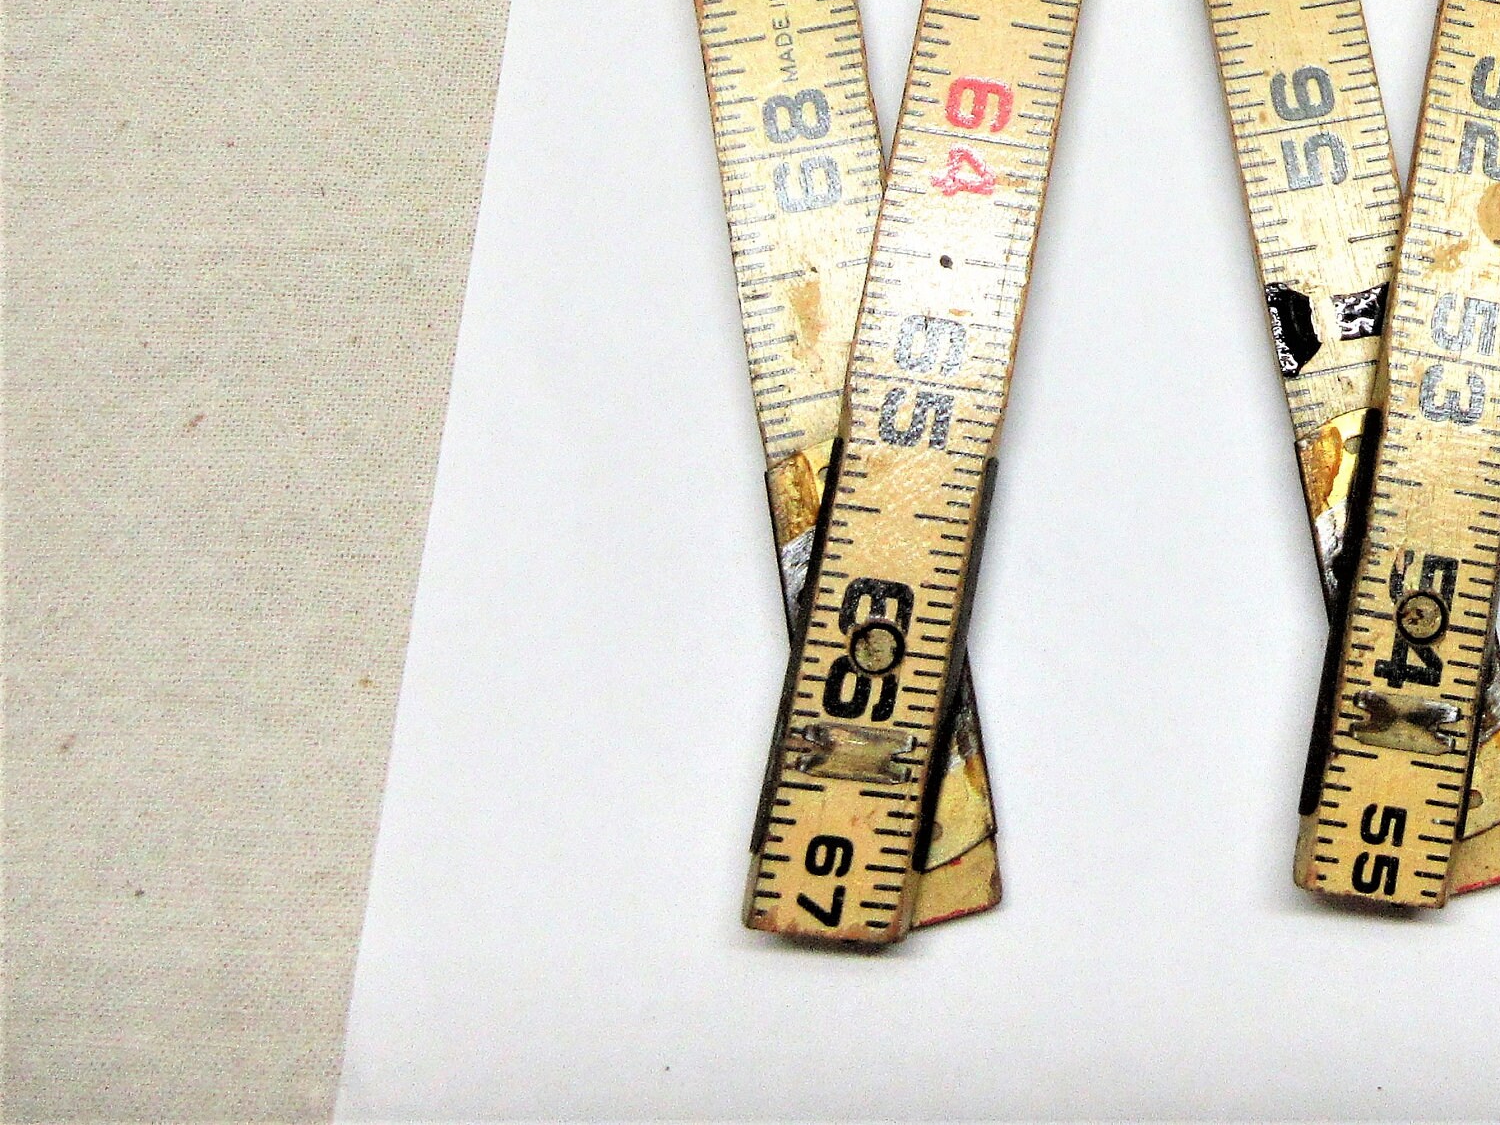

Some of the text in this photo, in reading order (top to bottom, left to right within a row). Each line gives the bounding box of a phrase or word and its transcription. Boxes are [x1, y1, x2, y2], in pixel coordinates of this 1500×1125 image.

[772, 14, 799, 83] MADE
[762, 87, 842, 213] 68
[930, 76, 1014, 196] 64
[1269, 65, 1348, 192] 56
[878, 314, 967, 450] 65
[1418, 290, 1499, 427] 53
[823, 577, 914, 722] 66
[1373, 549, 1459, 689] 54
[796, 834, 854, 928] 67
[1352, 804, 1401, 897] 55
